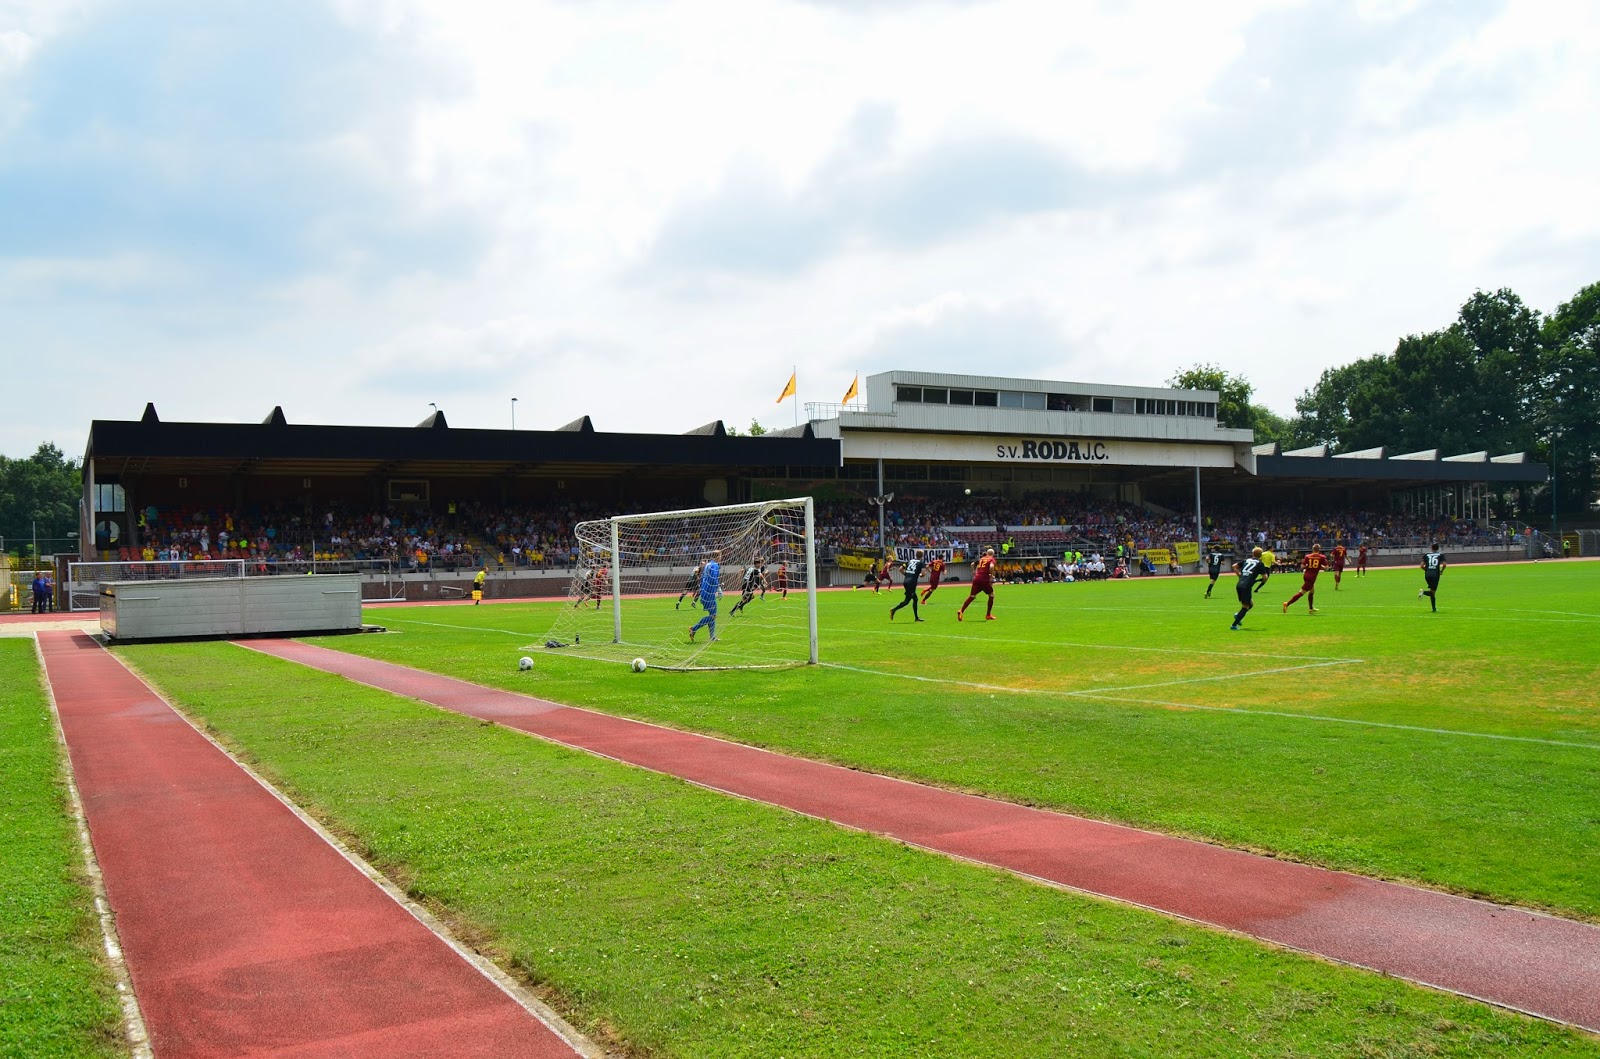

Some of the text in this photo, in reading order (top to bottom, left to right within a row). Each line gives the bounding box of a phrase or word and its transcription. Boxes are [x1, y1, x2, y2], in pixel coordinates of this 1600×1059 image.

[997, 440, 1109, 460] S.V. RODA J.C.
[896, 547, 915, 561] BAD
[978, 559, 988, 568] 12
[1213, 555, 1219, 564] 6
[1308, 559, 1320, 569] 18
[1428, 555, 1439, 566] 16
[907, 561, 917, 571] 24
[1242, 561, 1257, 574] 22
